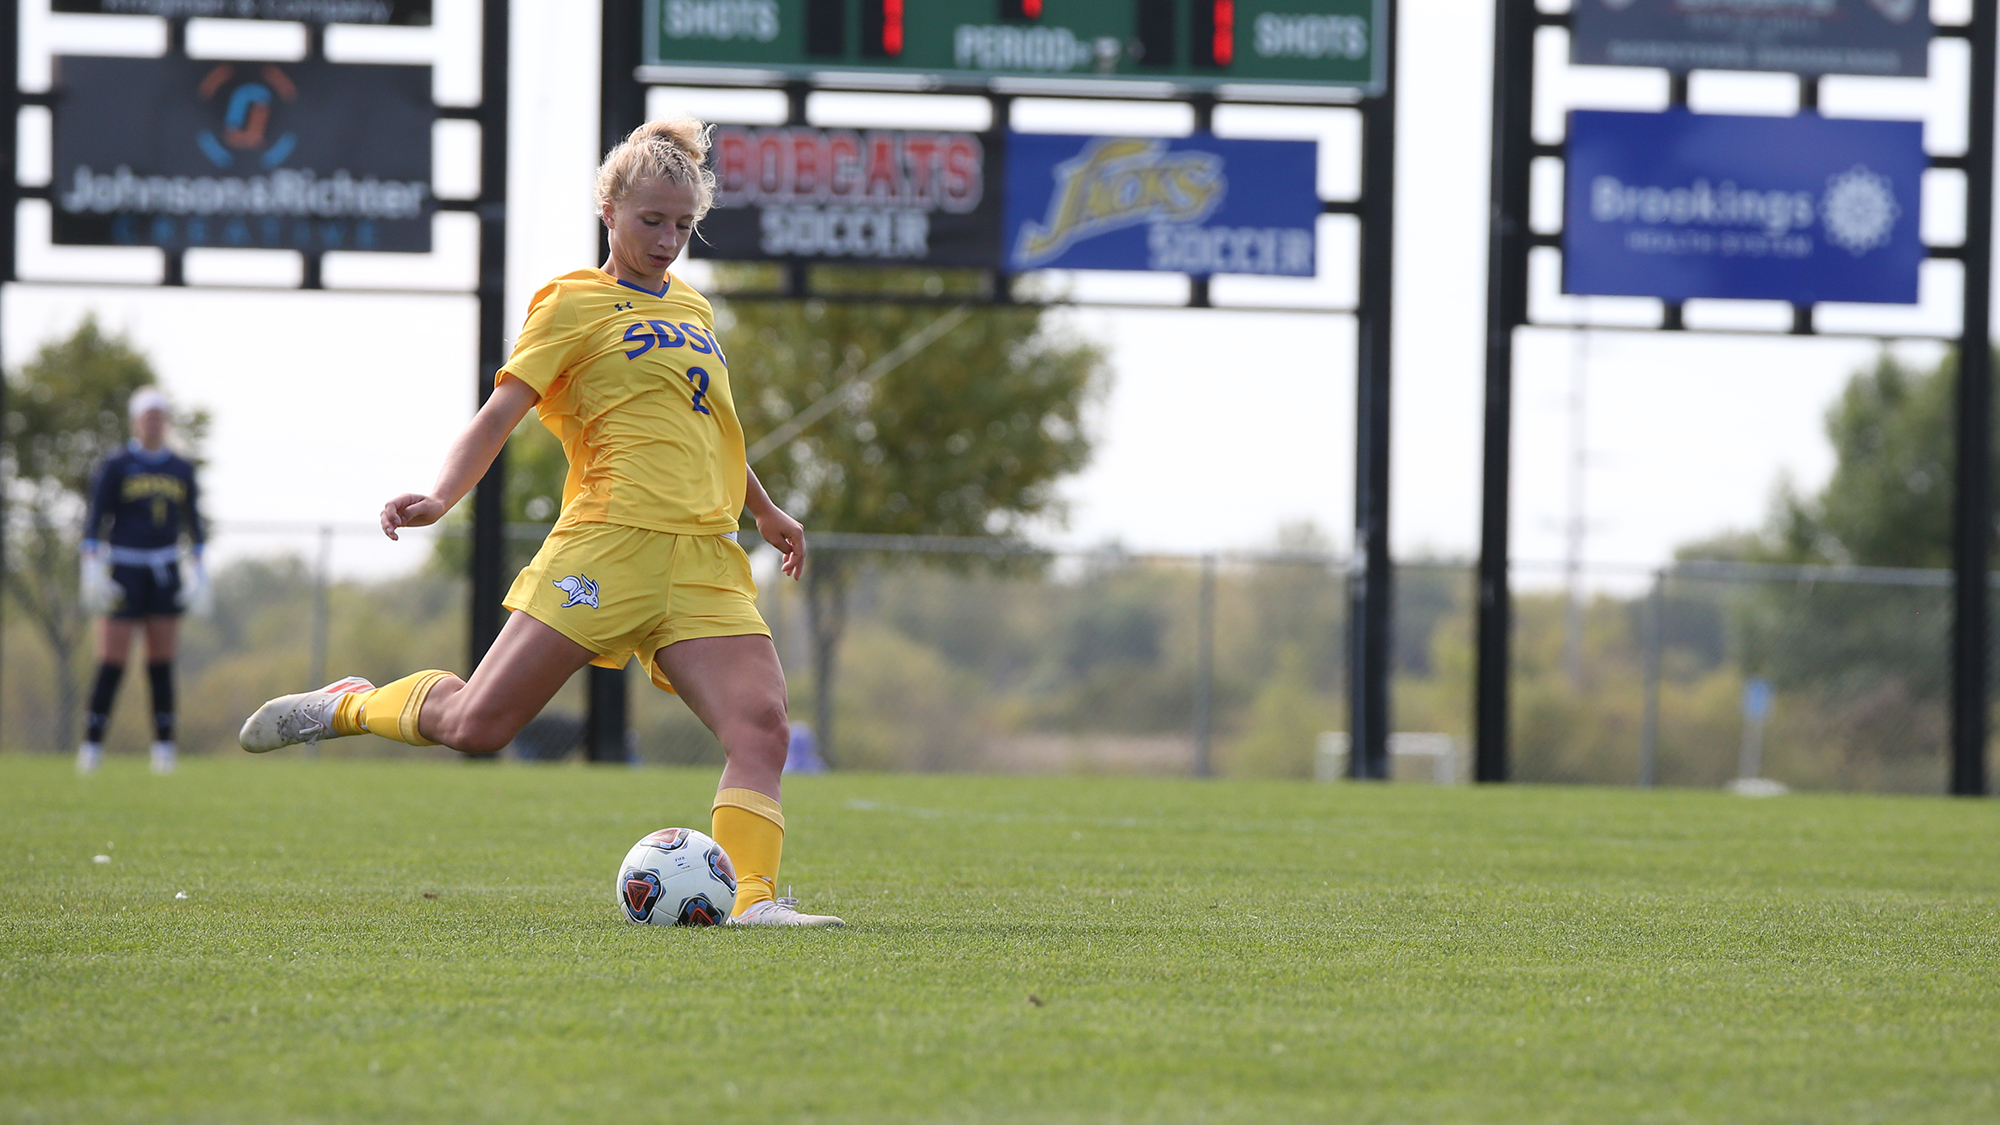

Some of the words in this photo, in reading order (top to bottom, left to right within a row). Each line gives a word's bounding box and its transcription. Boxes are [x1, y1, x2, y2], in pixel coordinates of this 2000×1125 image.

[664, 0, 779, 41] SHOTS
[1254, 12, 1367, 60] SHOTS
[954, 24, 1078, 70] PERIOD
[716, 129, 983, 210] BOBCATS
[112, 214, 376, 248] CREATIVE
[1591, 176, 1814, 237] Brookings
[760, 206, 929, 257] SOCCER
[1149, 222, 1313, 275] SOCCER
[686, 366, 711, 415] 2
